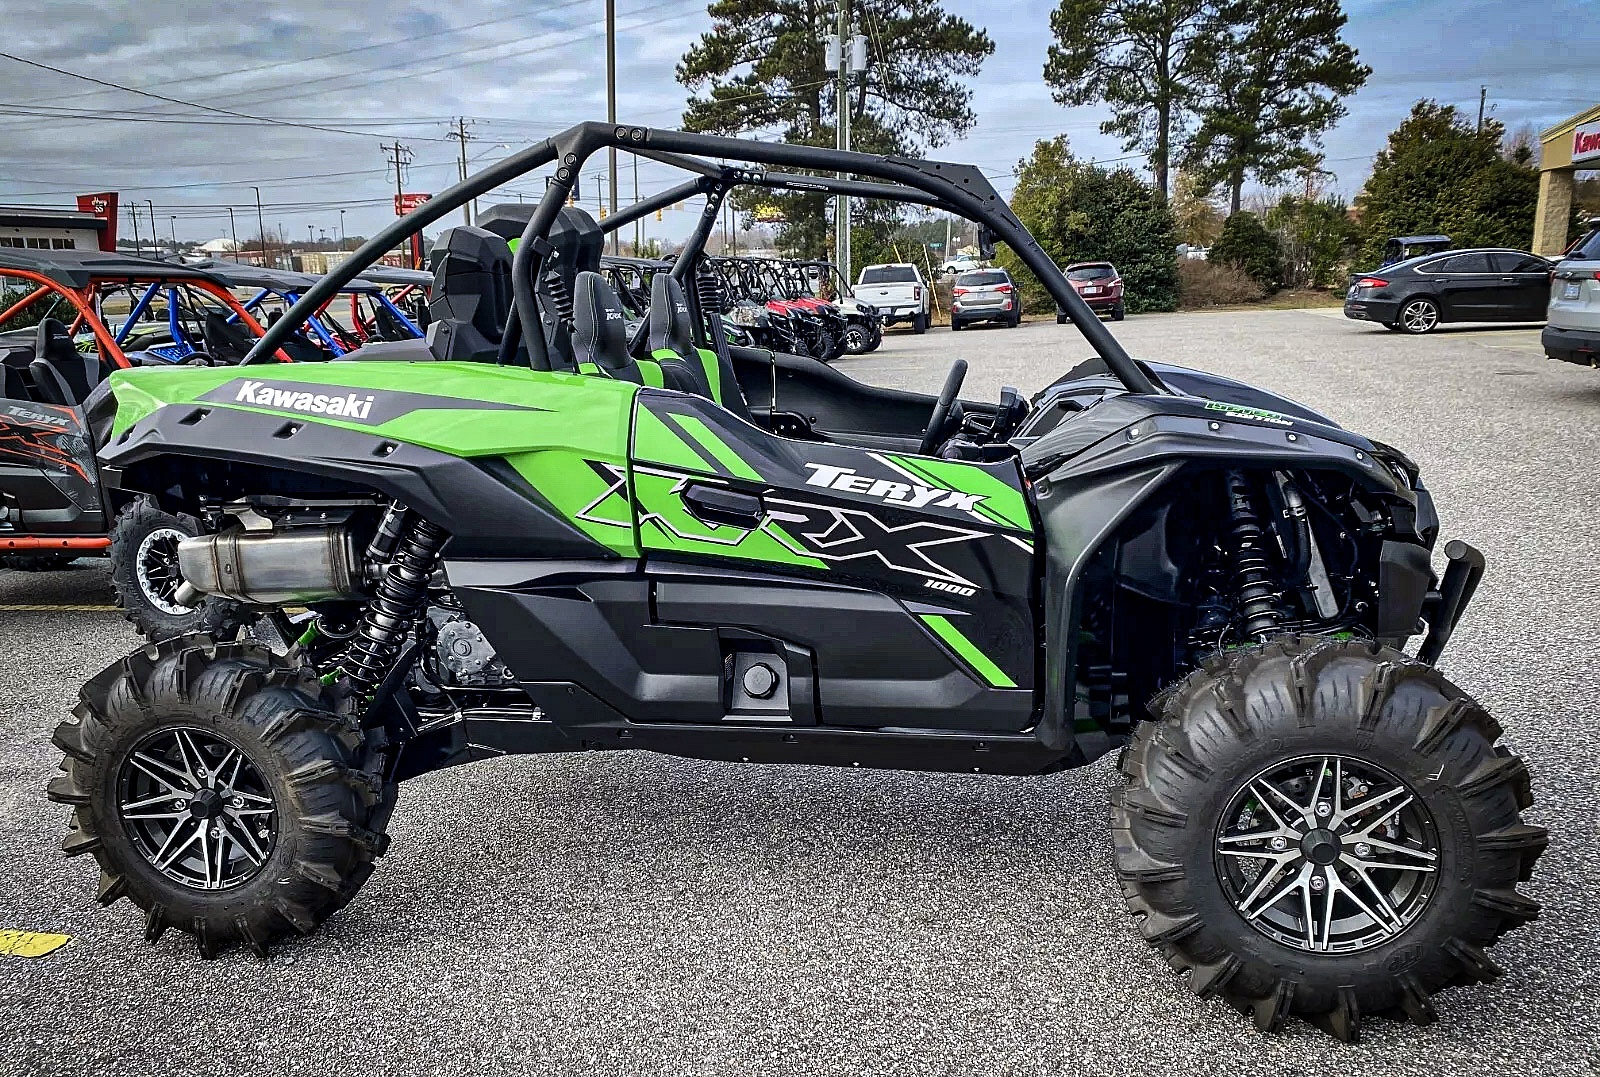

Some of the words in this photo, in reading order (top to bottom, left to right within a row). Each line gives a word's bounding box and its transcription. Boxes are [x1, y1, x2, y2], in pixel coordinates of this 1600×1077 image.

[235, 380, 375, 419] Kawasaki
[8, 405, 70, 426] TERYX
[1225, 411, 1294, 426] EDITION
[804, 462, 991, 512] TERYX
[923, 579, 977, 597] 1000
